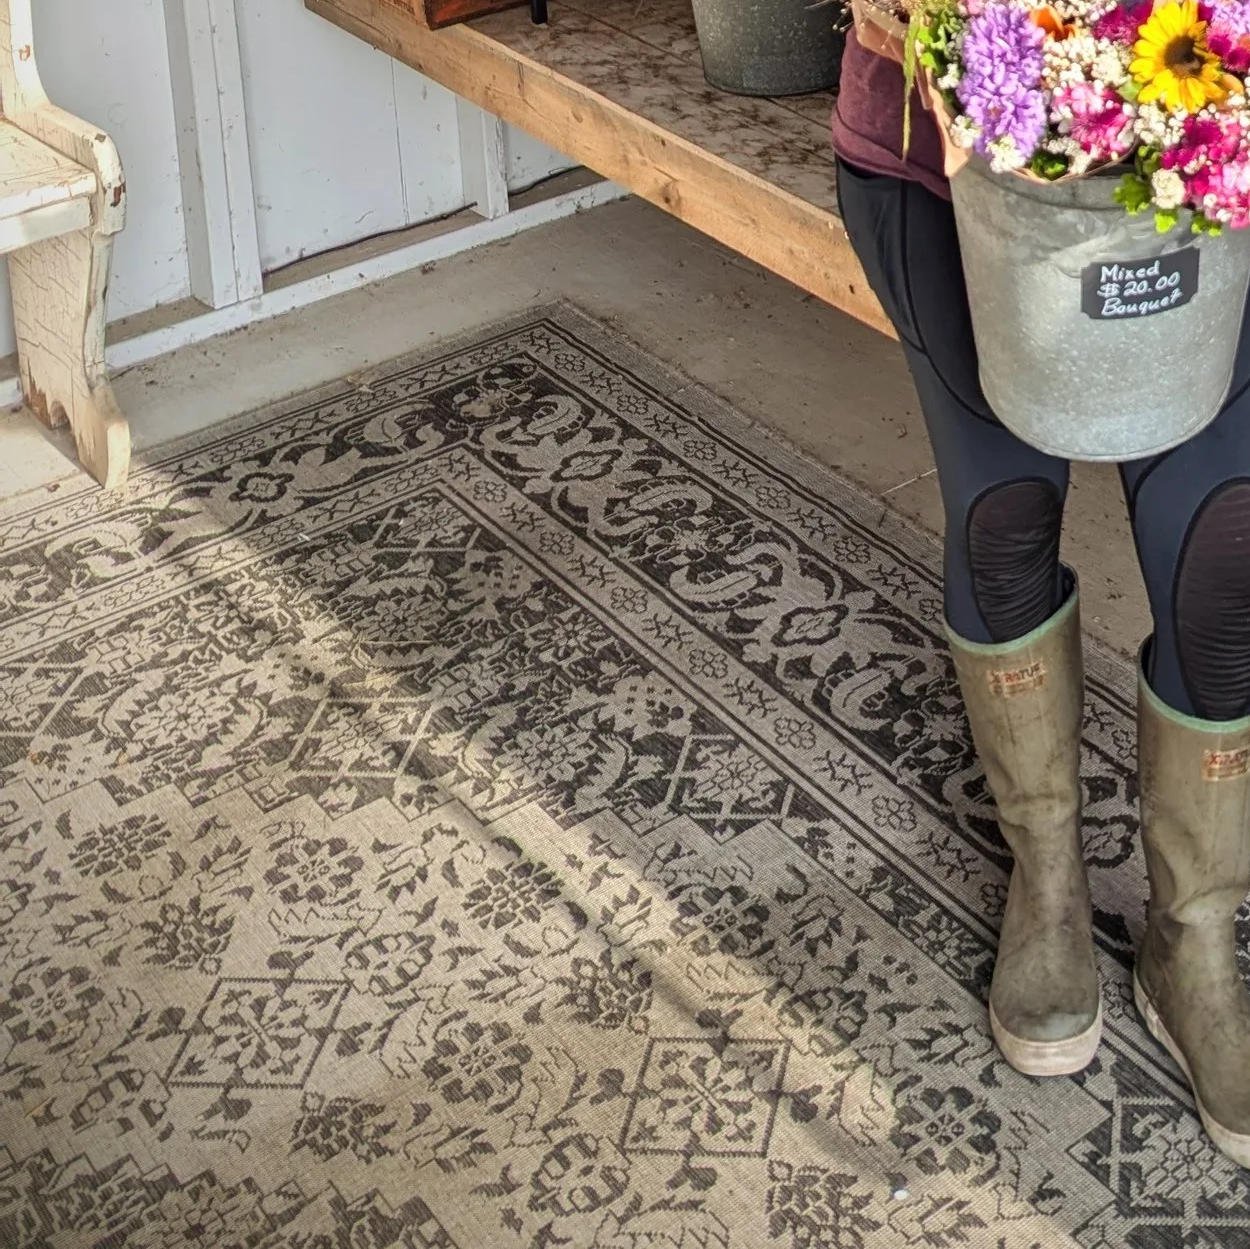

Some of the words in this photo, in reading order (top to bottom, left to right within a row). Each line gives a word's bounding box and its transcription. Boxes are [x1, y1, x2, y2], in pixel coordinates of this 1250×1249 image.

[1097, 271, 1180, 298] $20.00
[1100, 260, 1160, 283] Mixed
[1101, 287, 1184, 316] Bouquet
